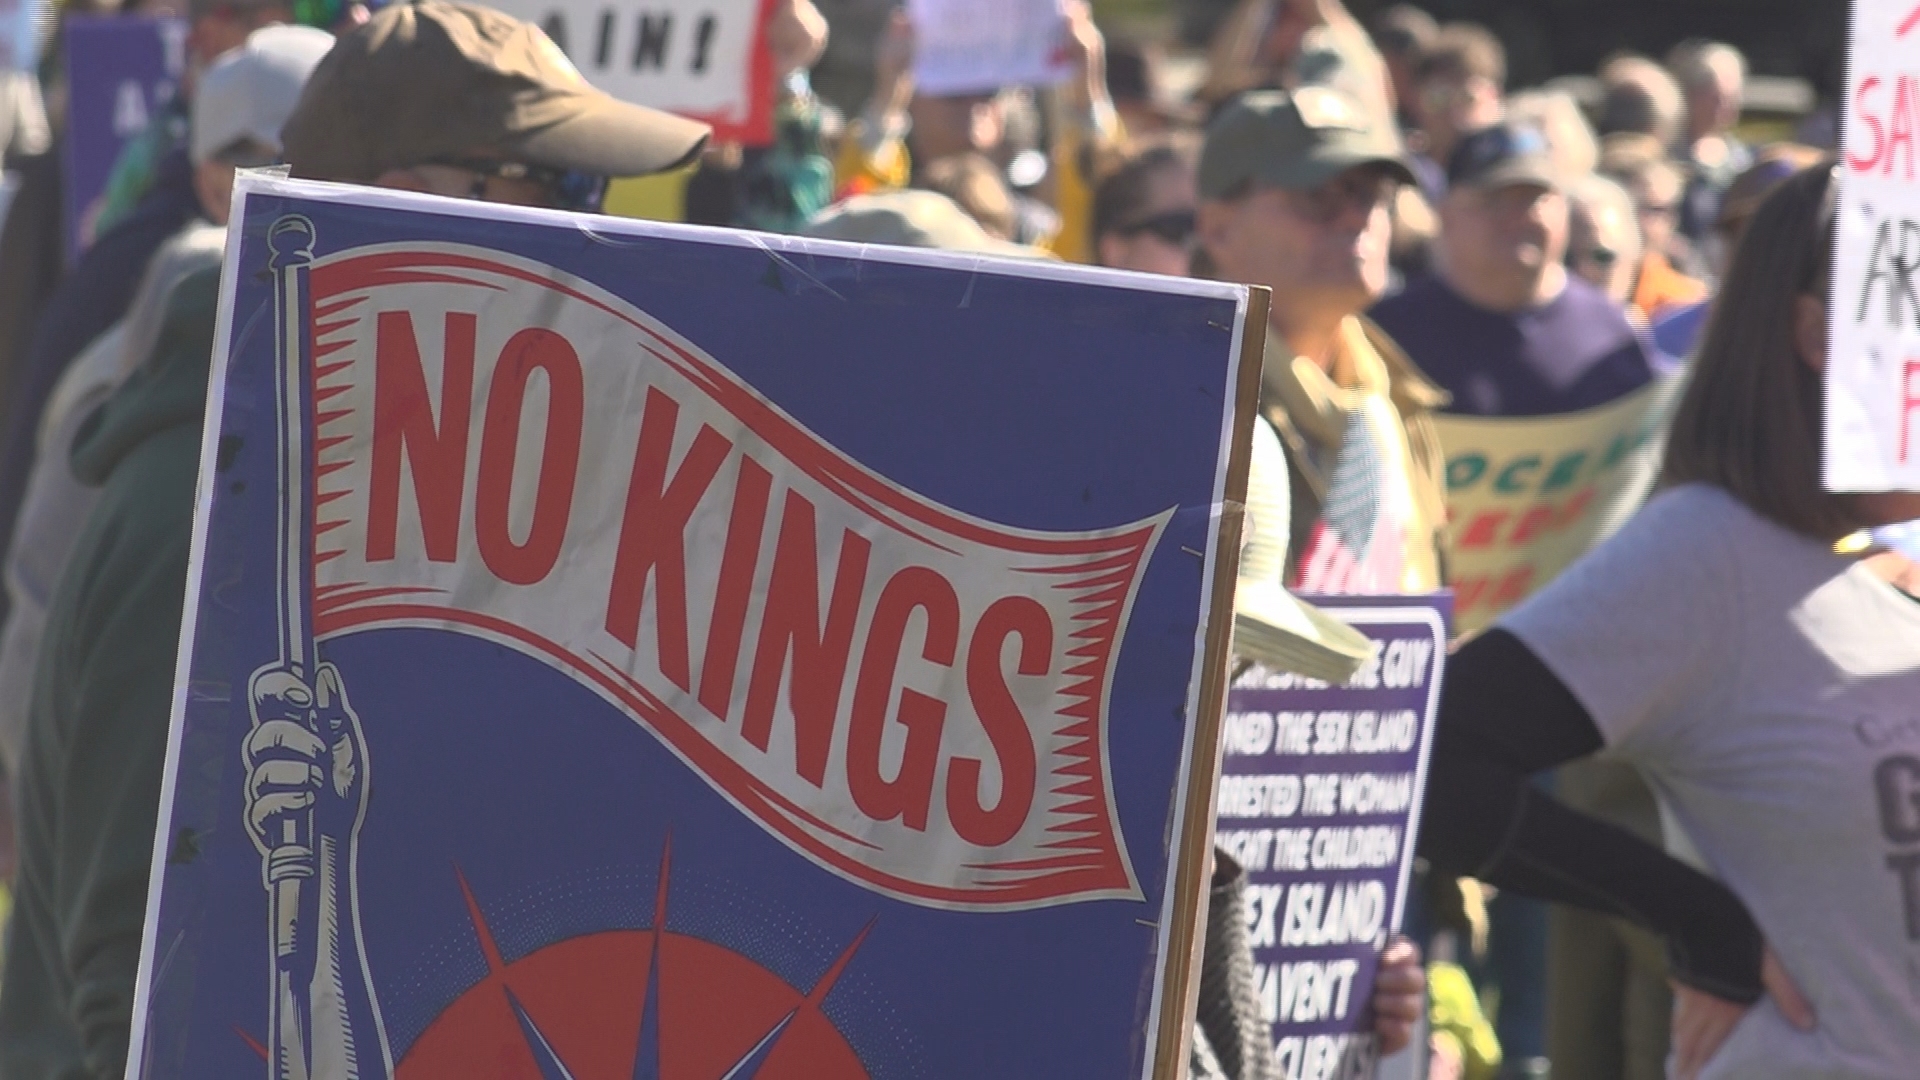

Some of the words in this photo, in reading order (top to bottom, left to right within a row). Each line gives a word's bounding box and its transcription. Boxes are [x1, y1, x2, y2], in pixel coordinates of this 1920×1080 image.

[365, 310, 584, 585] NO
[604, 384, 1053, 847] KINGS
[1383, 638, 1434, 689] GUY
[1275, 711, 1317, 756] THE
[1313, 710, 1350, 755] SEX
[1351, 709, 1418, 754] ISLAND
[1302, 773, 1340, 817] THE
[1340, 772, 1412, 815] WOMAN
[1274, 827, 1312, 871] THE
[1311, 824, 1399, 870] CHILDREN
[1281, 880, 1387, 953] ISLAND,
